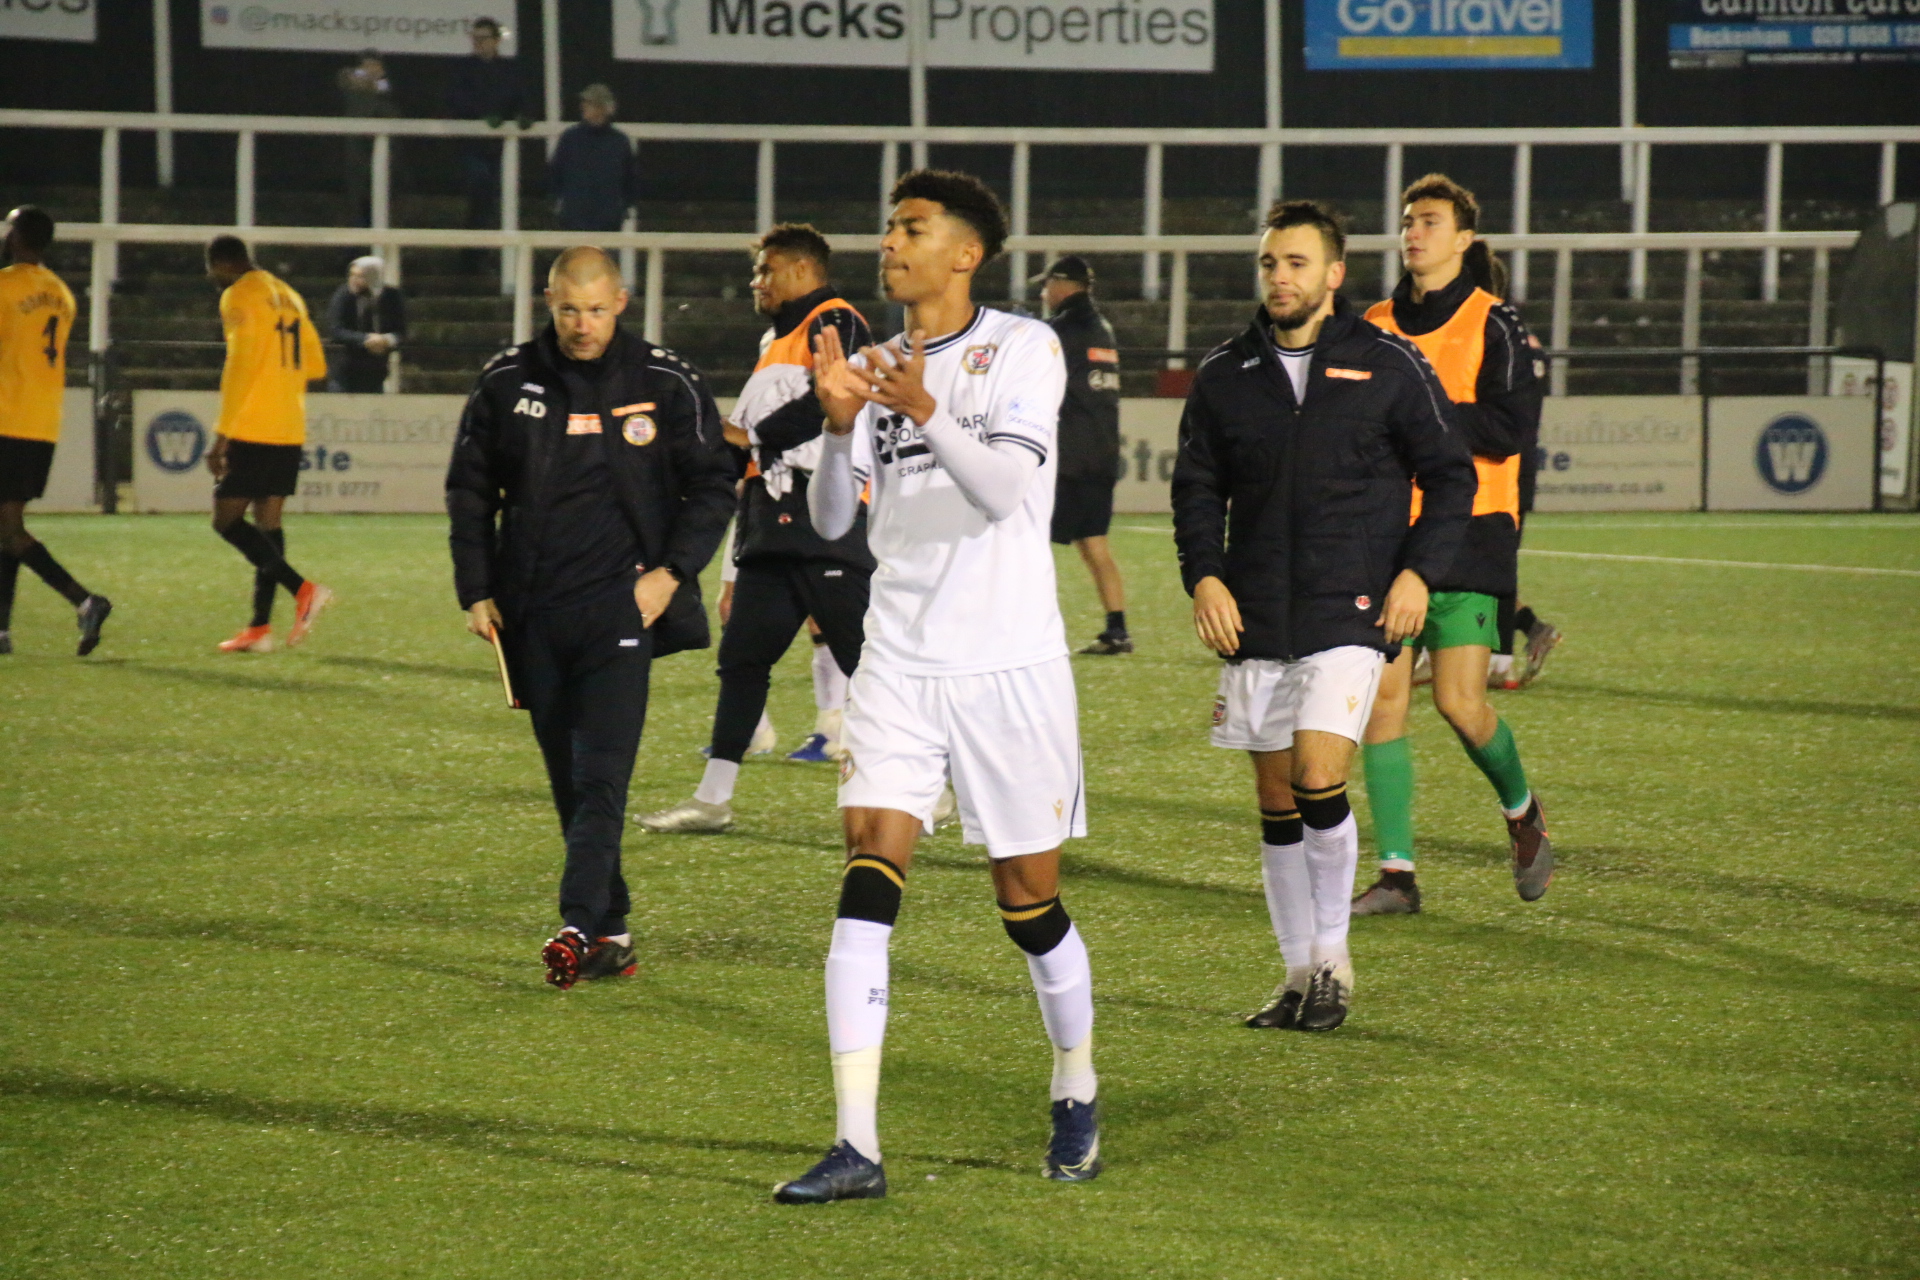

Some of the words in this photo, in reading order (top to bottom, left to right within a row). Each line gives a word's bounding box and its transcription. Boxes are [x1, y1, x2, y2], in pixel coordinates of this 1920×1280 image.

[709, 0, 904, 39] Macks
[928, 0, 1208, 53] Properties
[1337, 0, 1416, 33] Go
[275, 314, 302, 370] 11
[513, 397, 547, 419] AD
[300, 444, 352, 471] ste
[1766, 430, 1820, 483] W
